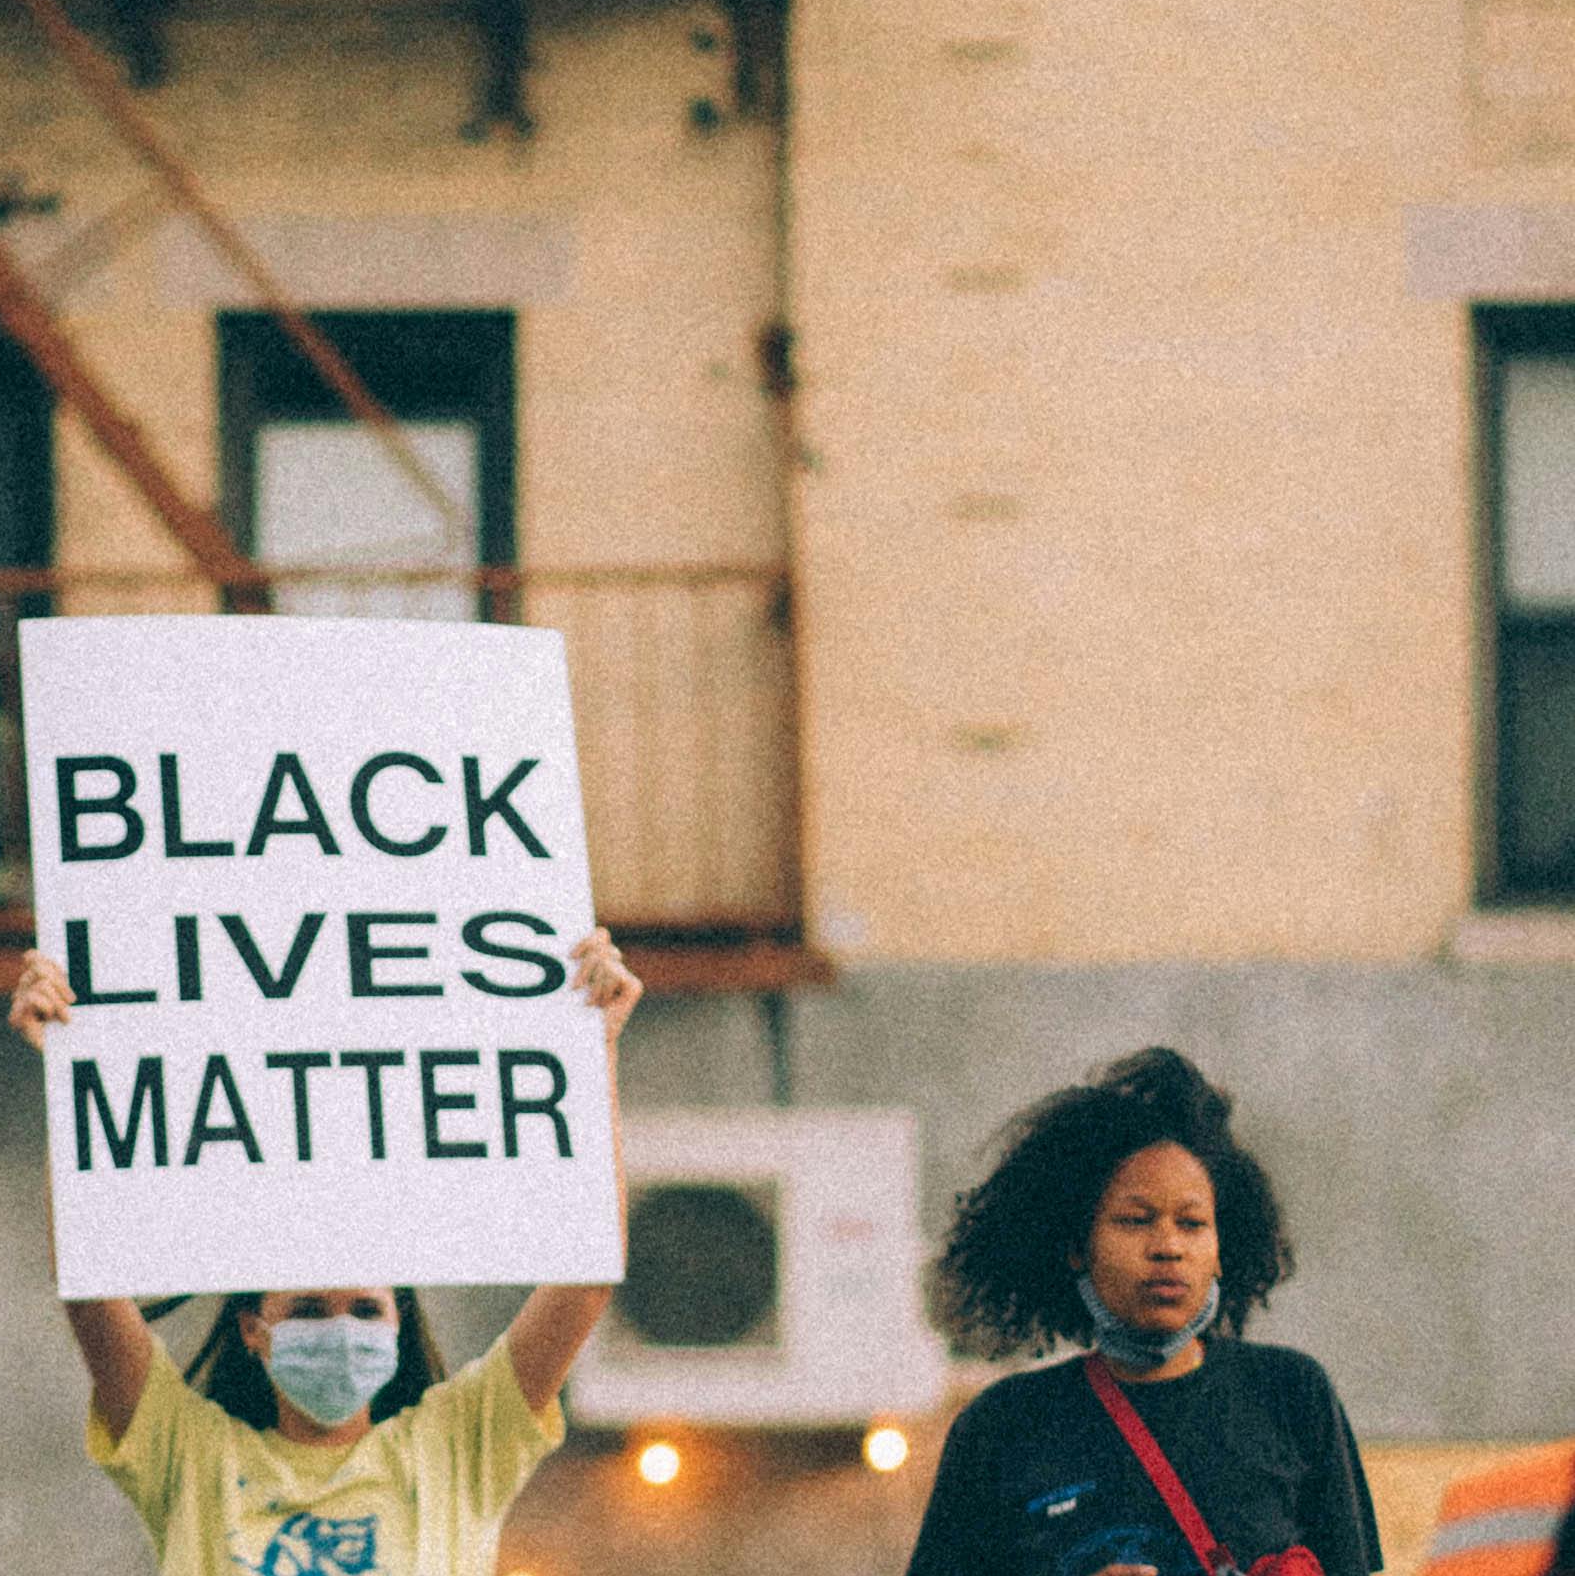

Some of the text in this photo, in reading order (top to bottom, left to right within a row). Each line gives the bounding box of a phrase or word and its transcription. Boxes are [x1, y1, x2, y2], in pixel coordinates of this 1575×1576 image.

[56, 752, 552, 862] BLACK
[64, 911, 566, 1006] LIVES
[72, 1049, 573, 1171] MATTER
